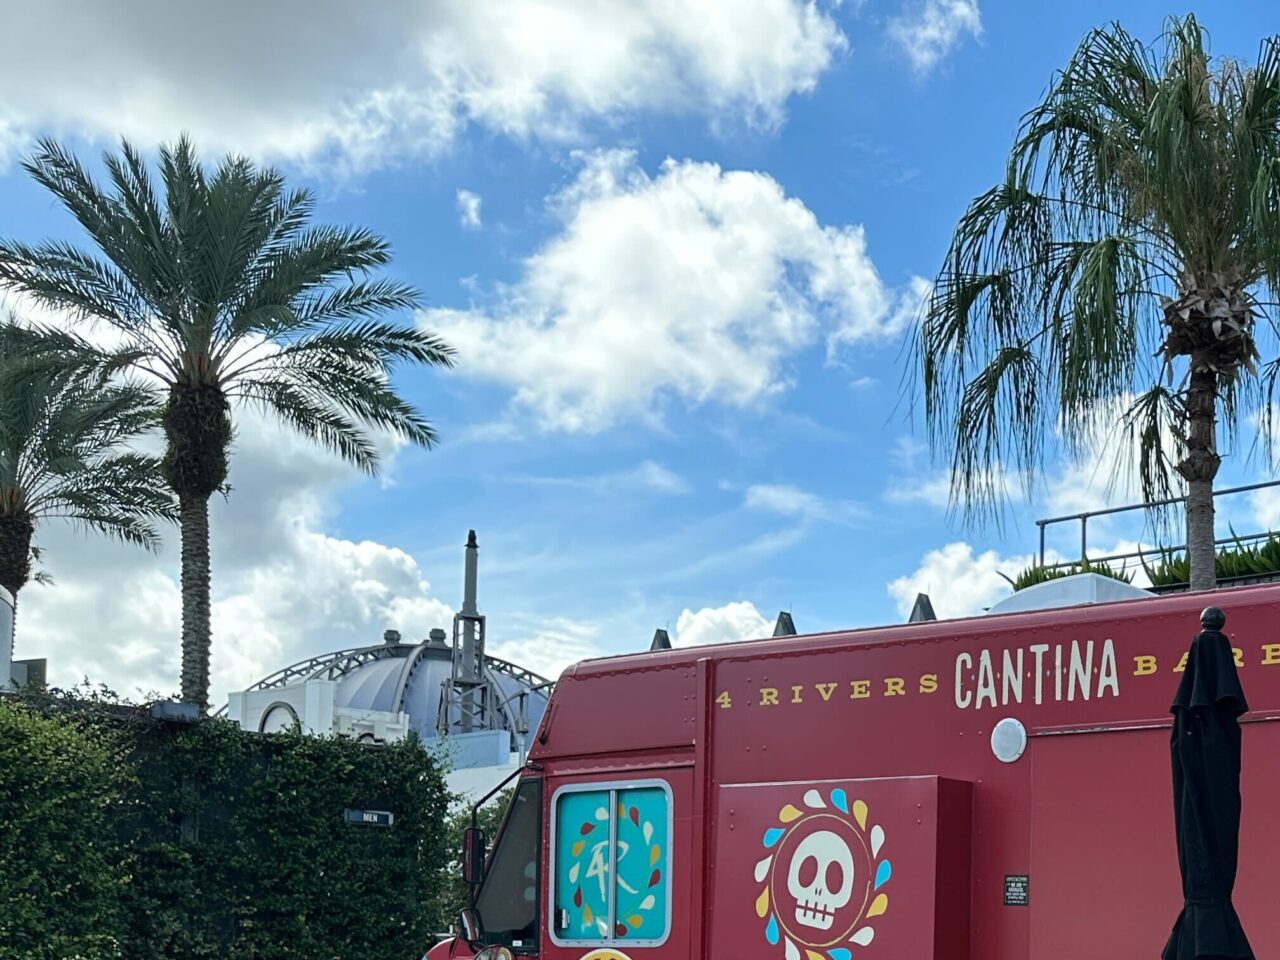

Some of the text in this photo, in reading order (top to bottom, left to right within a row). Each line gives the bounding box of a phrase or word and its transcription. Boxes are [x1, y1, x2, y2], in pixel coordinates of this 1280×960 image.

[715, 690, 732, 709] 4
[758, 674, 939, 706] RIVERS
[954, 638, 1121, 710] CANTINA
[363, 812, 378, 823] MEN
